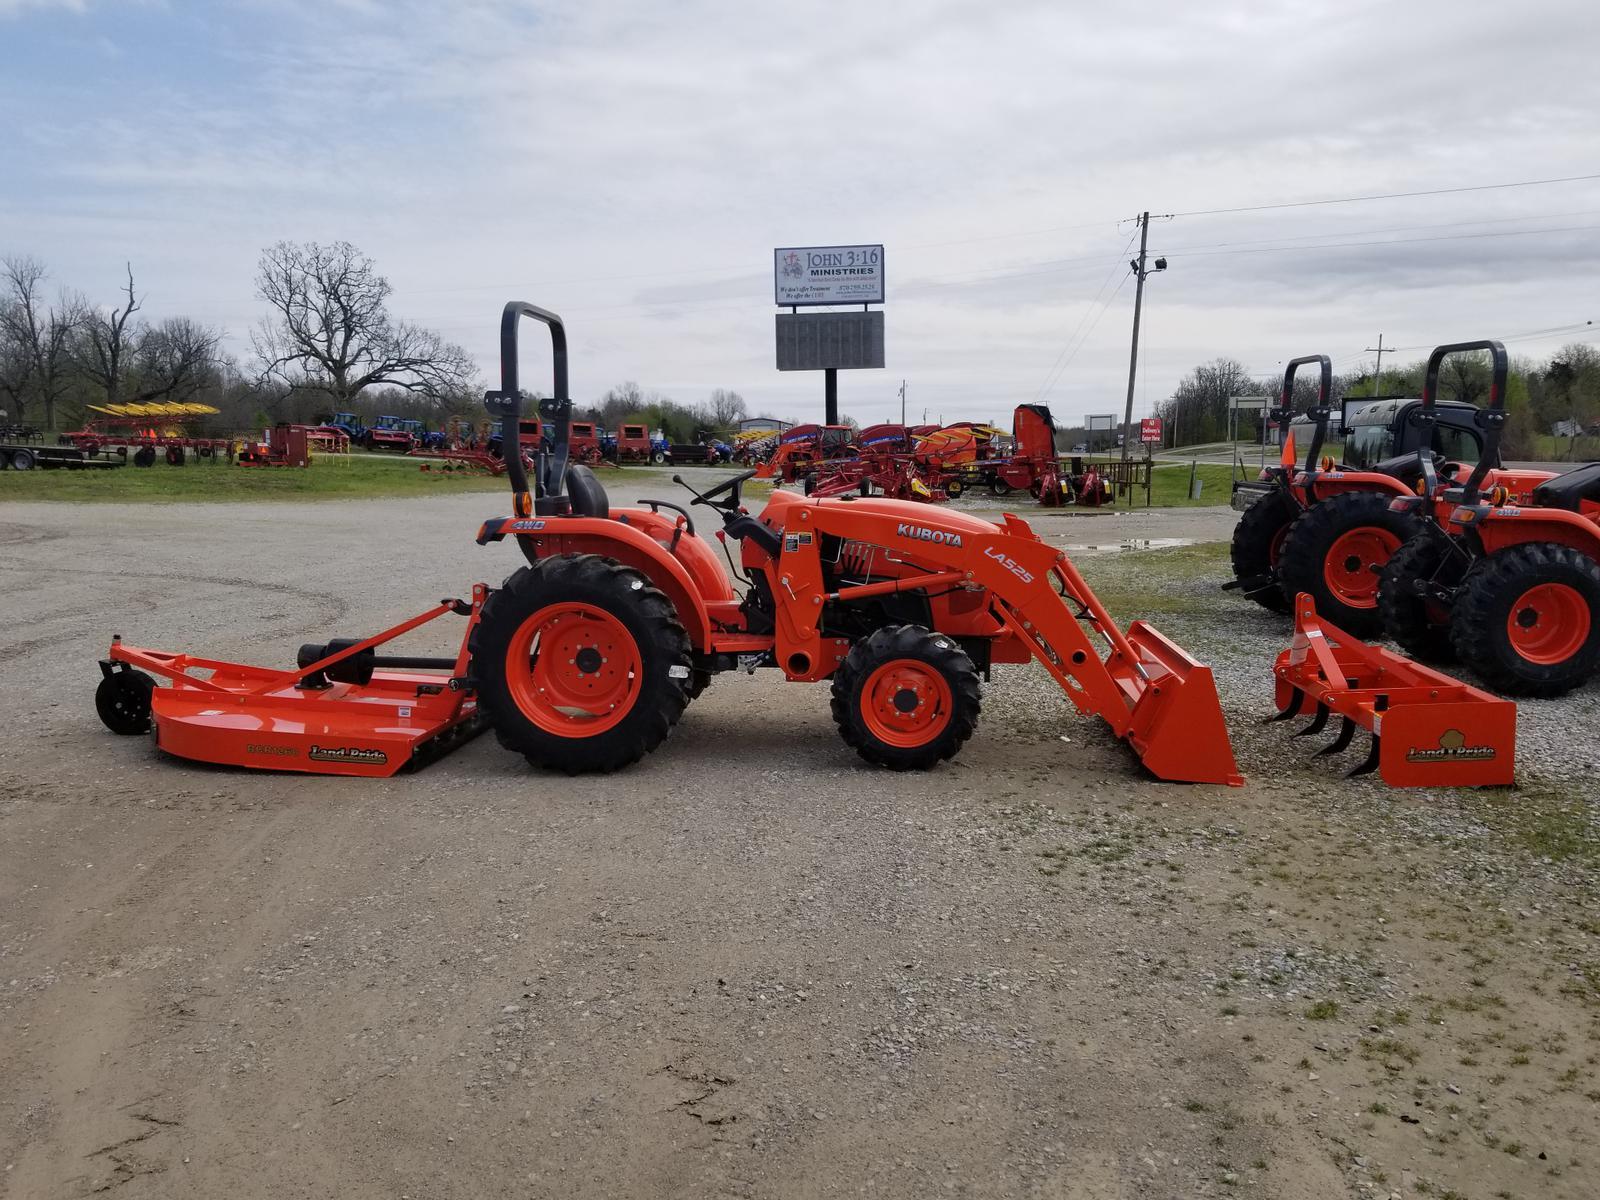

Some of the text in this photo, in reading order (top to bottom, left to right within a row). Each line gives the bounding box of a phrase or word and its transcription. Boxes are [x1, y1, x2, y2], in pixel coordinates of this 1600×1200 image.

[806, 248, 878, 269] JOHN 3:16
[810, 267, 874, 276] MINISTRIES
[511, 520, 545, 530] 4WD
[897, 523, 962, 548] KUBOTA
[984, 546, 1034, 584] LA525
[311, 746, 345, 758] Land
[1408, 747, 1445, 758] Land
